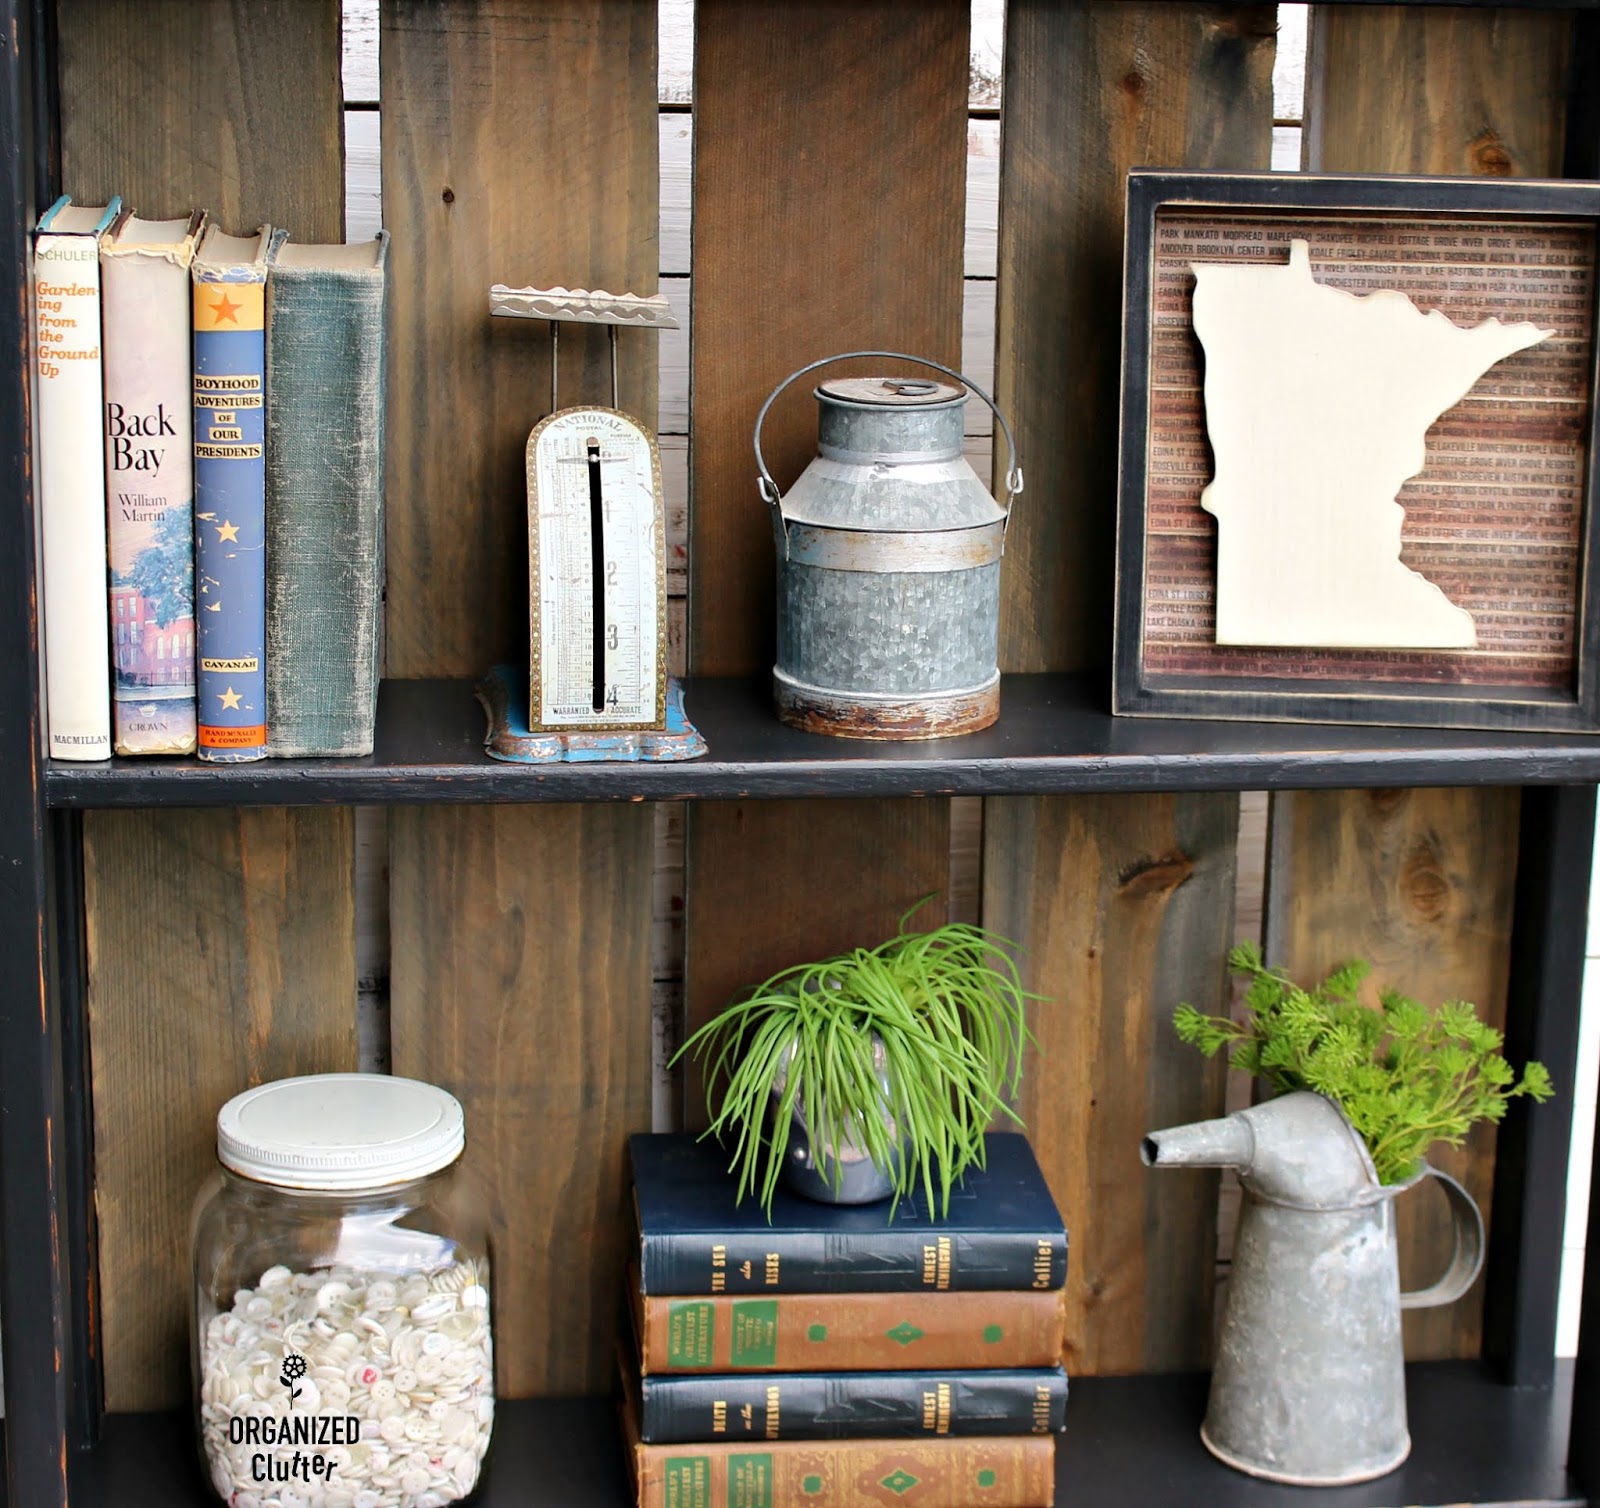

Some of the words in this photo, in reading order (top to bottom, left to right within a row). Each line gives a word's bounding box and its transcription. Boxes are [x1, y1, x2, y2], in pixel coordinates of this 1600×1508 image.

[1160, 229, 1179, 240] PARK
[1183, 229, 1219, 240] MANKATO
[1398, 235, 1430, 246] COTTAGE
[1434, 237, 1458, 247] GROVE
[1461, 237, 1484, 247] INVER
[1487, 238, 1511, 248] GROVE
[1159, 244, 1194, 255] ANDOVER
[1197, 245, 1234, 255] BROOKLYN
[1237, 246, 1265, 256] CENTER
[1490, 253, 1516, 263] AUSTIN
[1425, 267, 1444, 276] LAKE
[37, 282, 99, 297] Garden-
[38, 297, 62, 313] ing
[38, 313, 77, 329] from
[38, 330, 64, 343] the
[39, 345, 99, 361] Ground
[40, 363, 60, 380] Up
[195, 378, 259, 391] BOYHOOD
[195, 396, 260, 408] ADVENTURES
[107, 403, 177, 438] Back
[218, 414, 232, 424] OF
[554, 415, 627, 432] NATIONAL
[213, 429, 239, 440] OUR
[112, 437, 166, 478] Bay
[195, 446, 260, 458] PRESIDENTS
[118, 493, 168, 508] William
[122, 509, 166, 523] Martin
[607, 561, 618, 586] 2
[1147, 618, 1165, 626] LAKE
[1168, 618, 1195, 627] CHASKA
[607, 624, 618, 651] 3
[204, 661, 257, 670] CAVANAH
[606, 684, 619, 706] 4
[553, 707, 590, 715] WARRANTED
[610, 706, 642, 715] ACCURATE
[129, 722, 168, 732] CROWN
[54, 734, 109, 745] MACMILLAN
[765, 1253, 780, 1285] RISES
[923, 1245, 937, 1284] ERNEST
[937, 1236, 951, 1290] HEMINGWAY
[1032, 1239, 1052, 1289] Collier
[673, 1315, 682, 1356] WORLD'S
[686, 1311, 696, 1359] GREATEST
[698, 1306, 709, 1363] LITERATURE
[923, 1391, 937, 1429] ERNEST
[1031, 1385, 1051, 1433] Collier
